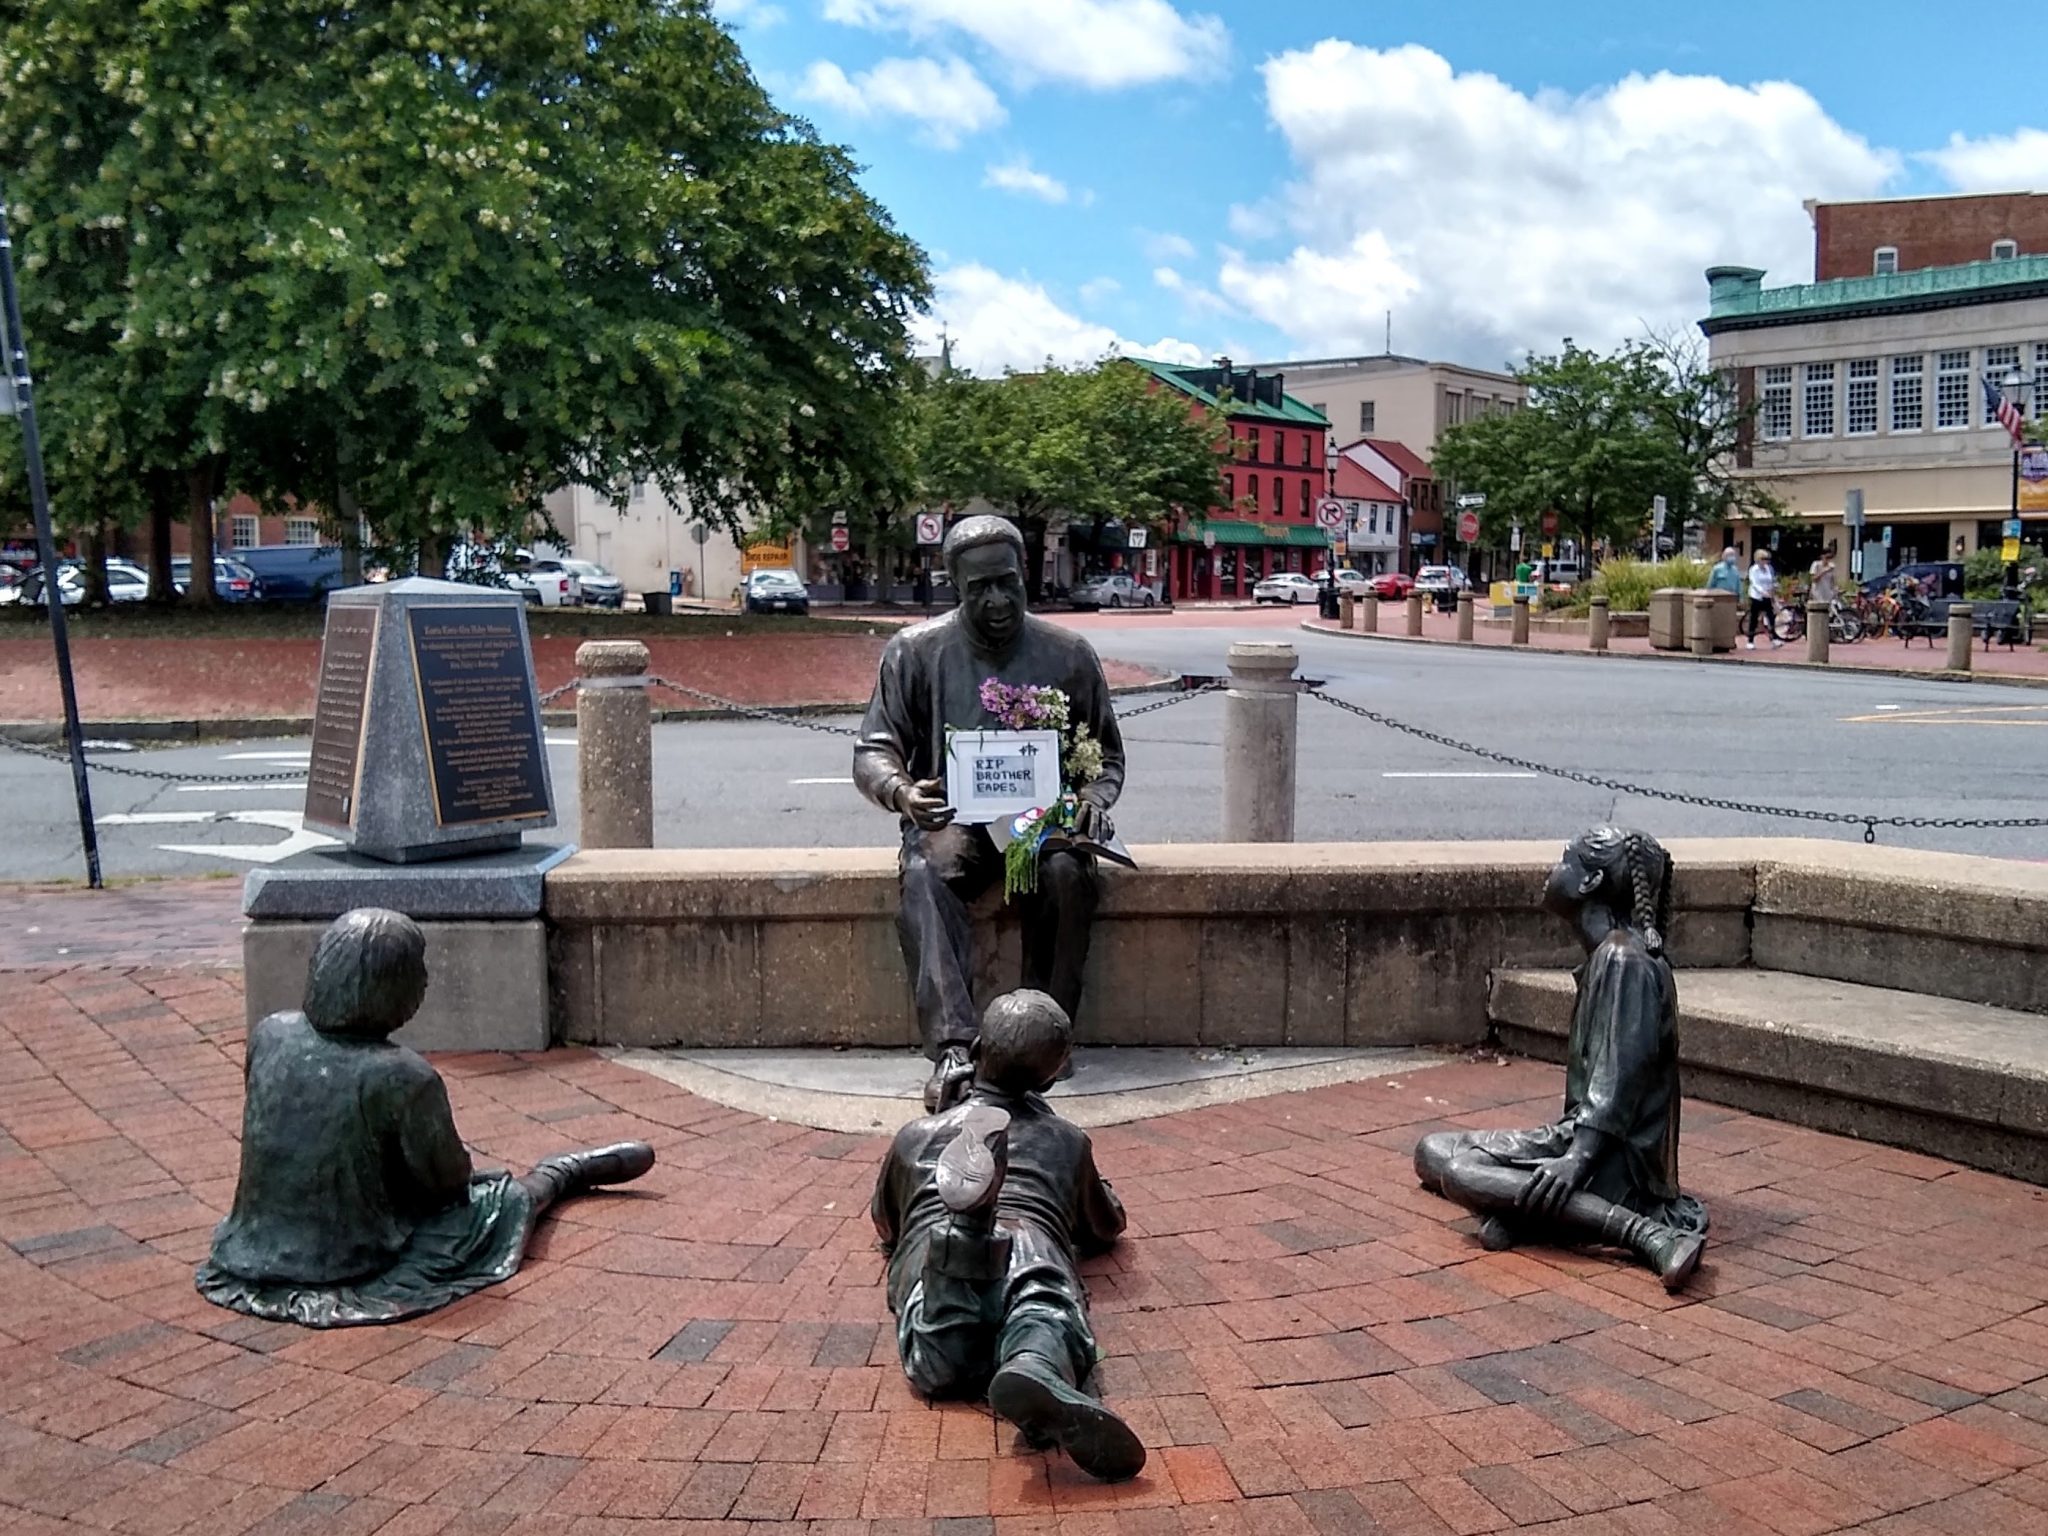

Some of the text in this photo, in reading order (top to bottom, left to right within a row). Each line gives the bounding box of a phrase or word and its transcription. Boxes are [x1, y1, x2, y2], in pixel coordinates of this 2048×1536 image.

[1462, 522, 1476, 532] STOP
[976, 759, 1004, 769] RIP
[976, 770, 1031, 781] BROTHER
[976, 783, 1017, 793] EADES
